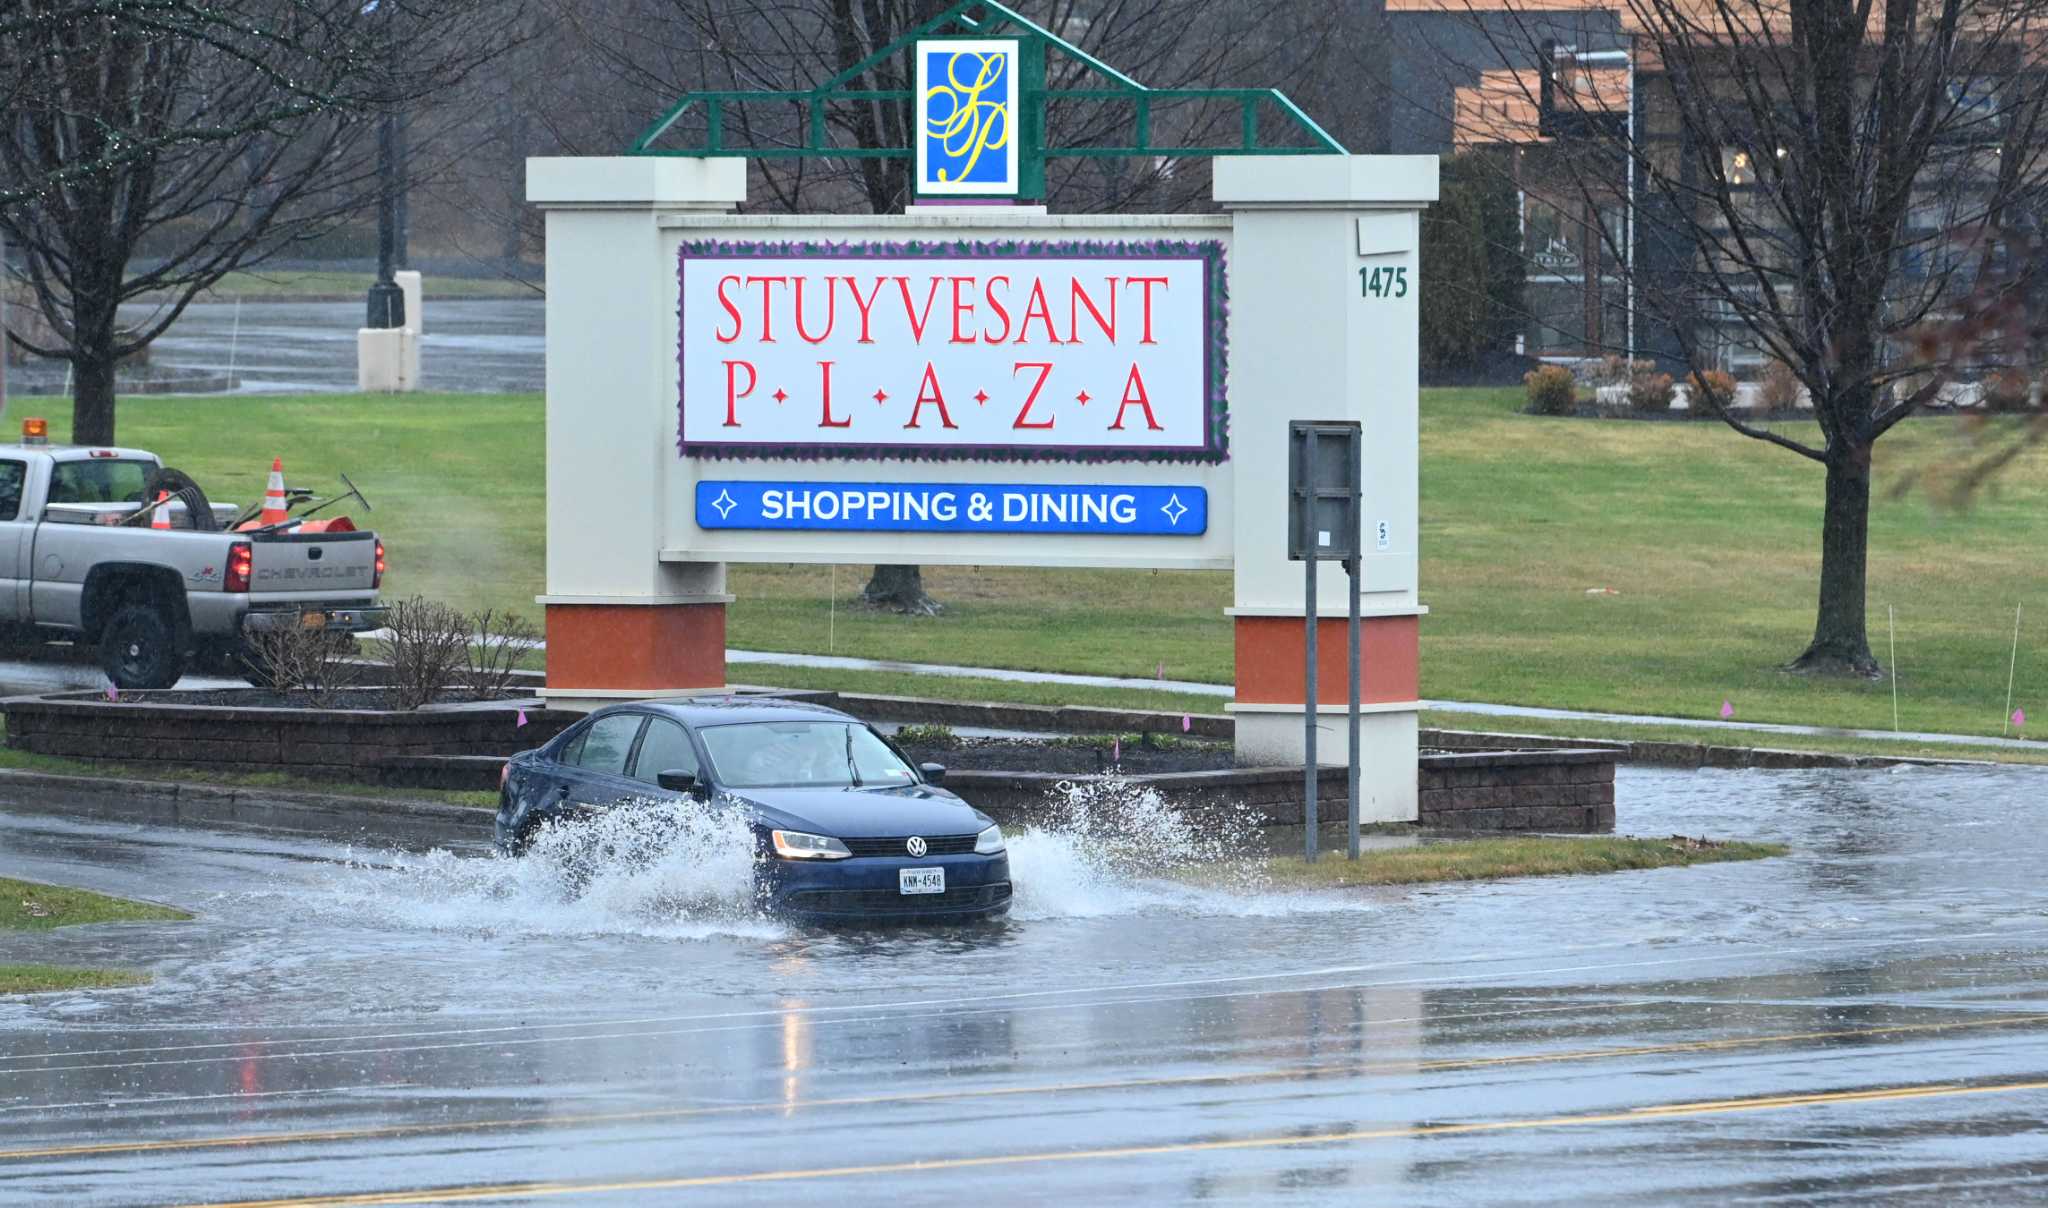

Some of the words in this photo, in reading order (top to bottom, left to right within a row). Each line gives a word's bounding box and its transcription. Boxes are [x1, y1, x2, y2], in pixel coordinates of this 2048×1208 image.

[1359, 266, 1408, 298] 1475
[715, 275, 1169, 346] STUYVESANT
[761, 489, 957, 522] SHOPPING
[967, 492, 993, 522] &
[1002, 493, 1137, 524] DINING
[257, 566, 369, 580] CHEVROLET
